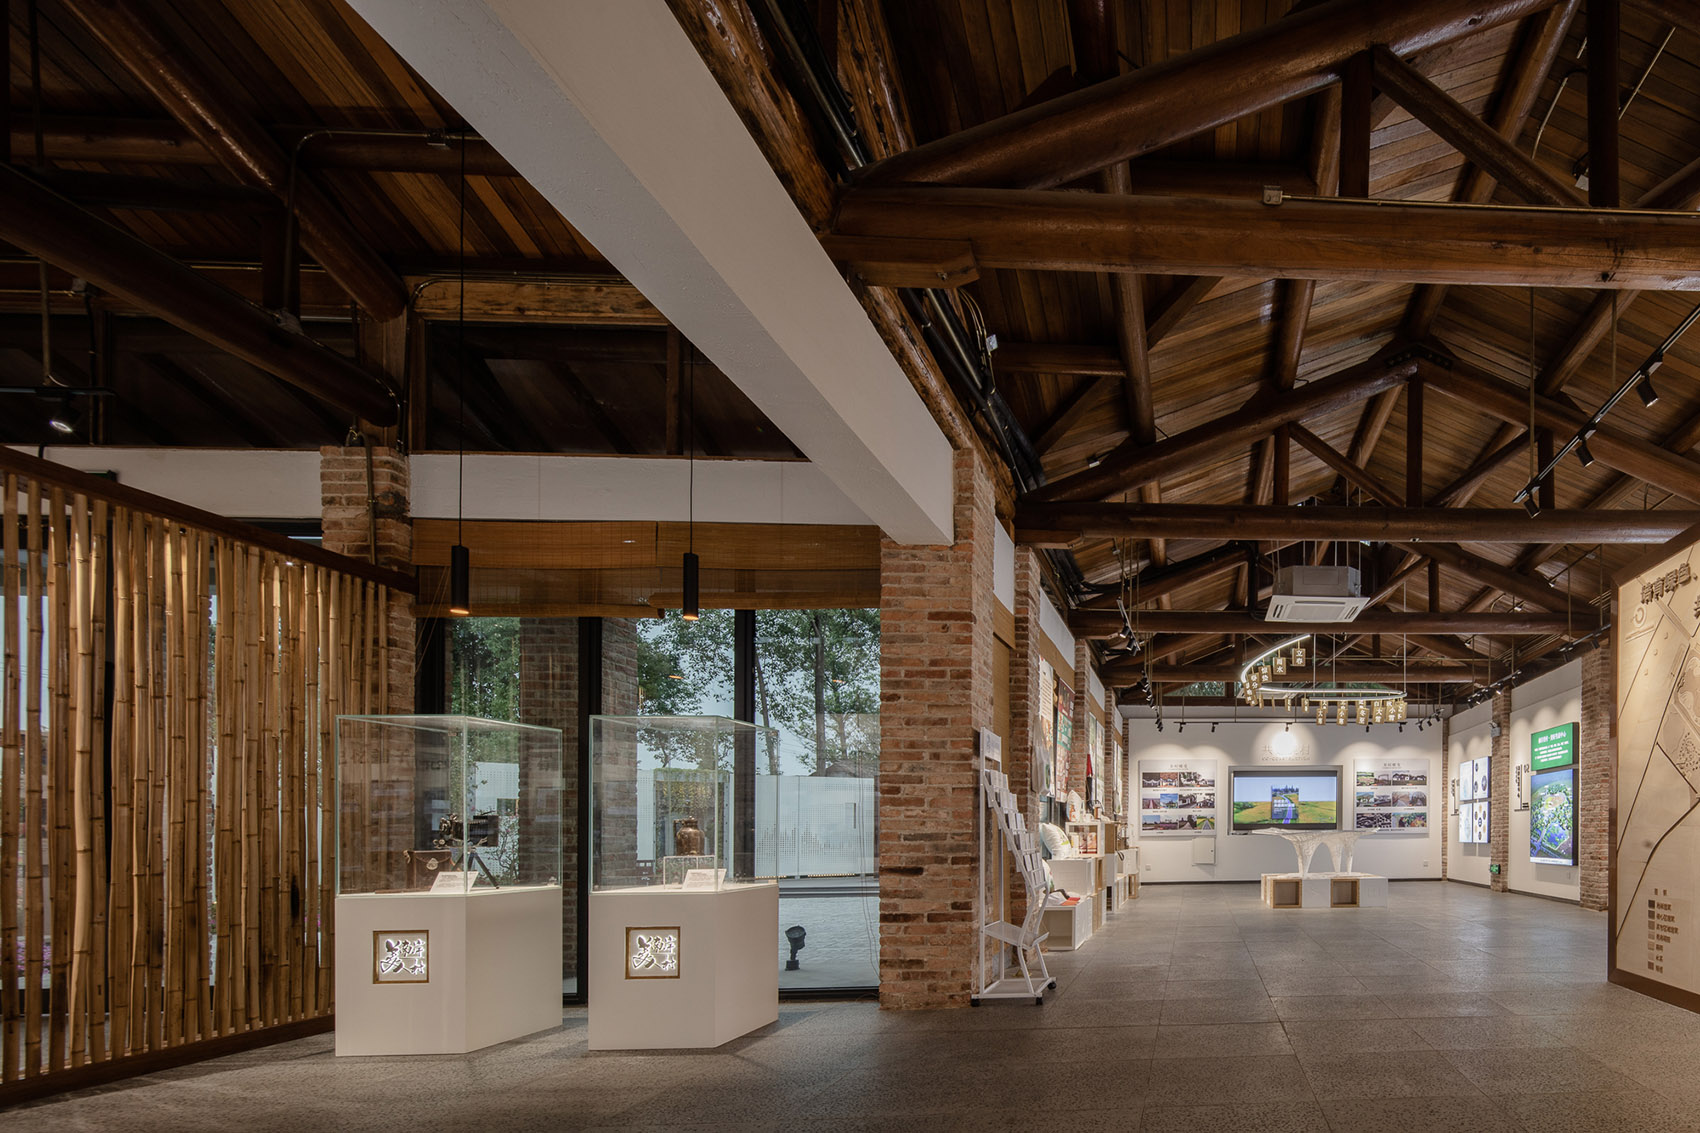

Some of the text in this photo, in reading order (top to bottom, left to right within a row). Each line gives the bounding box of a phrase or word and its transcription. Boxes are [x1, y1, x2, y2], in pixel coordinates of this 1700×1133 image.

[1296, 650, 1303, 664] 立春
[1277, 658, 1283, 673] 雨水
[1359, 709, 1366, 724] 冬至
